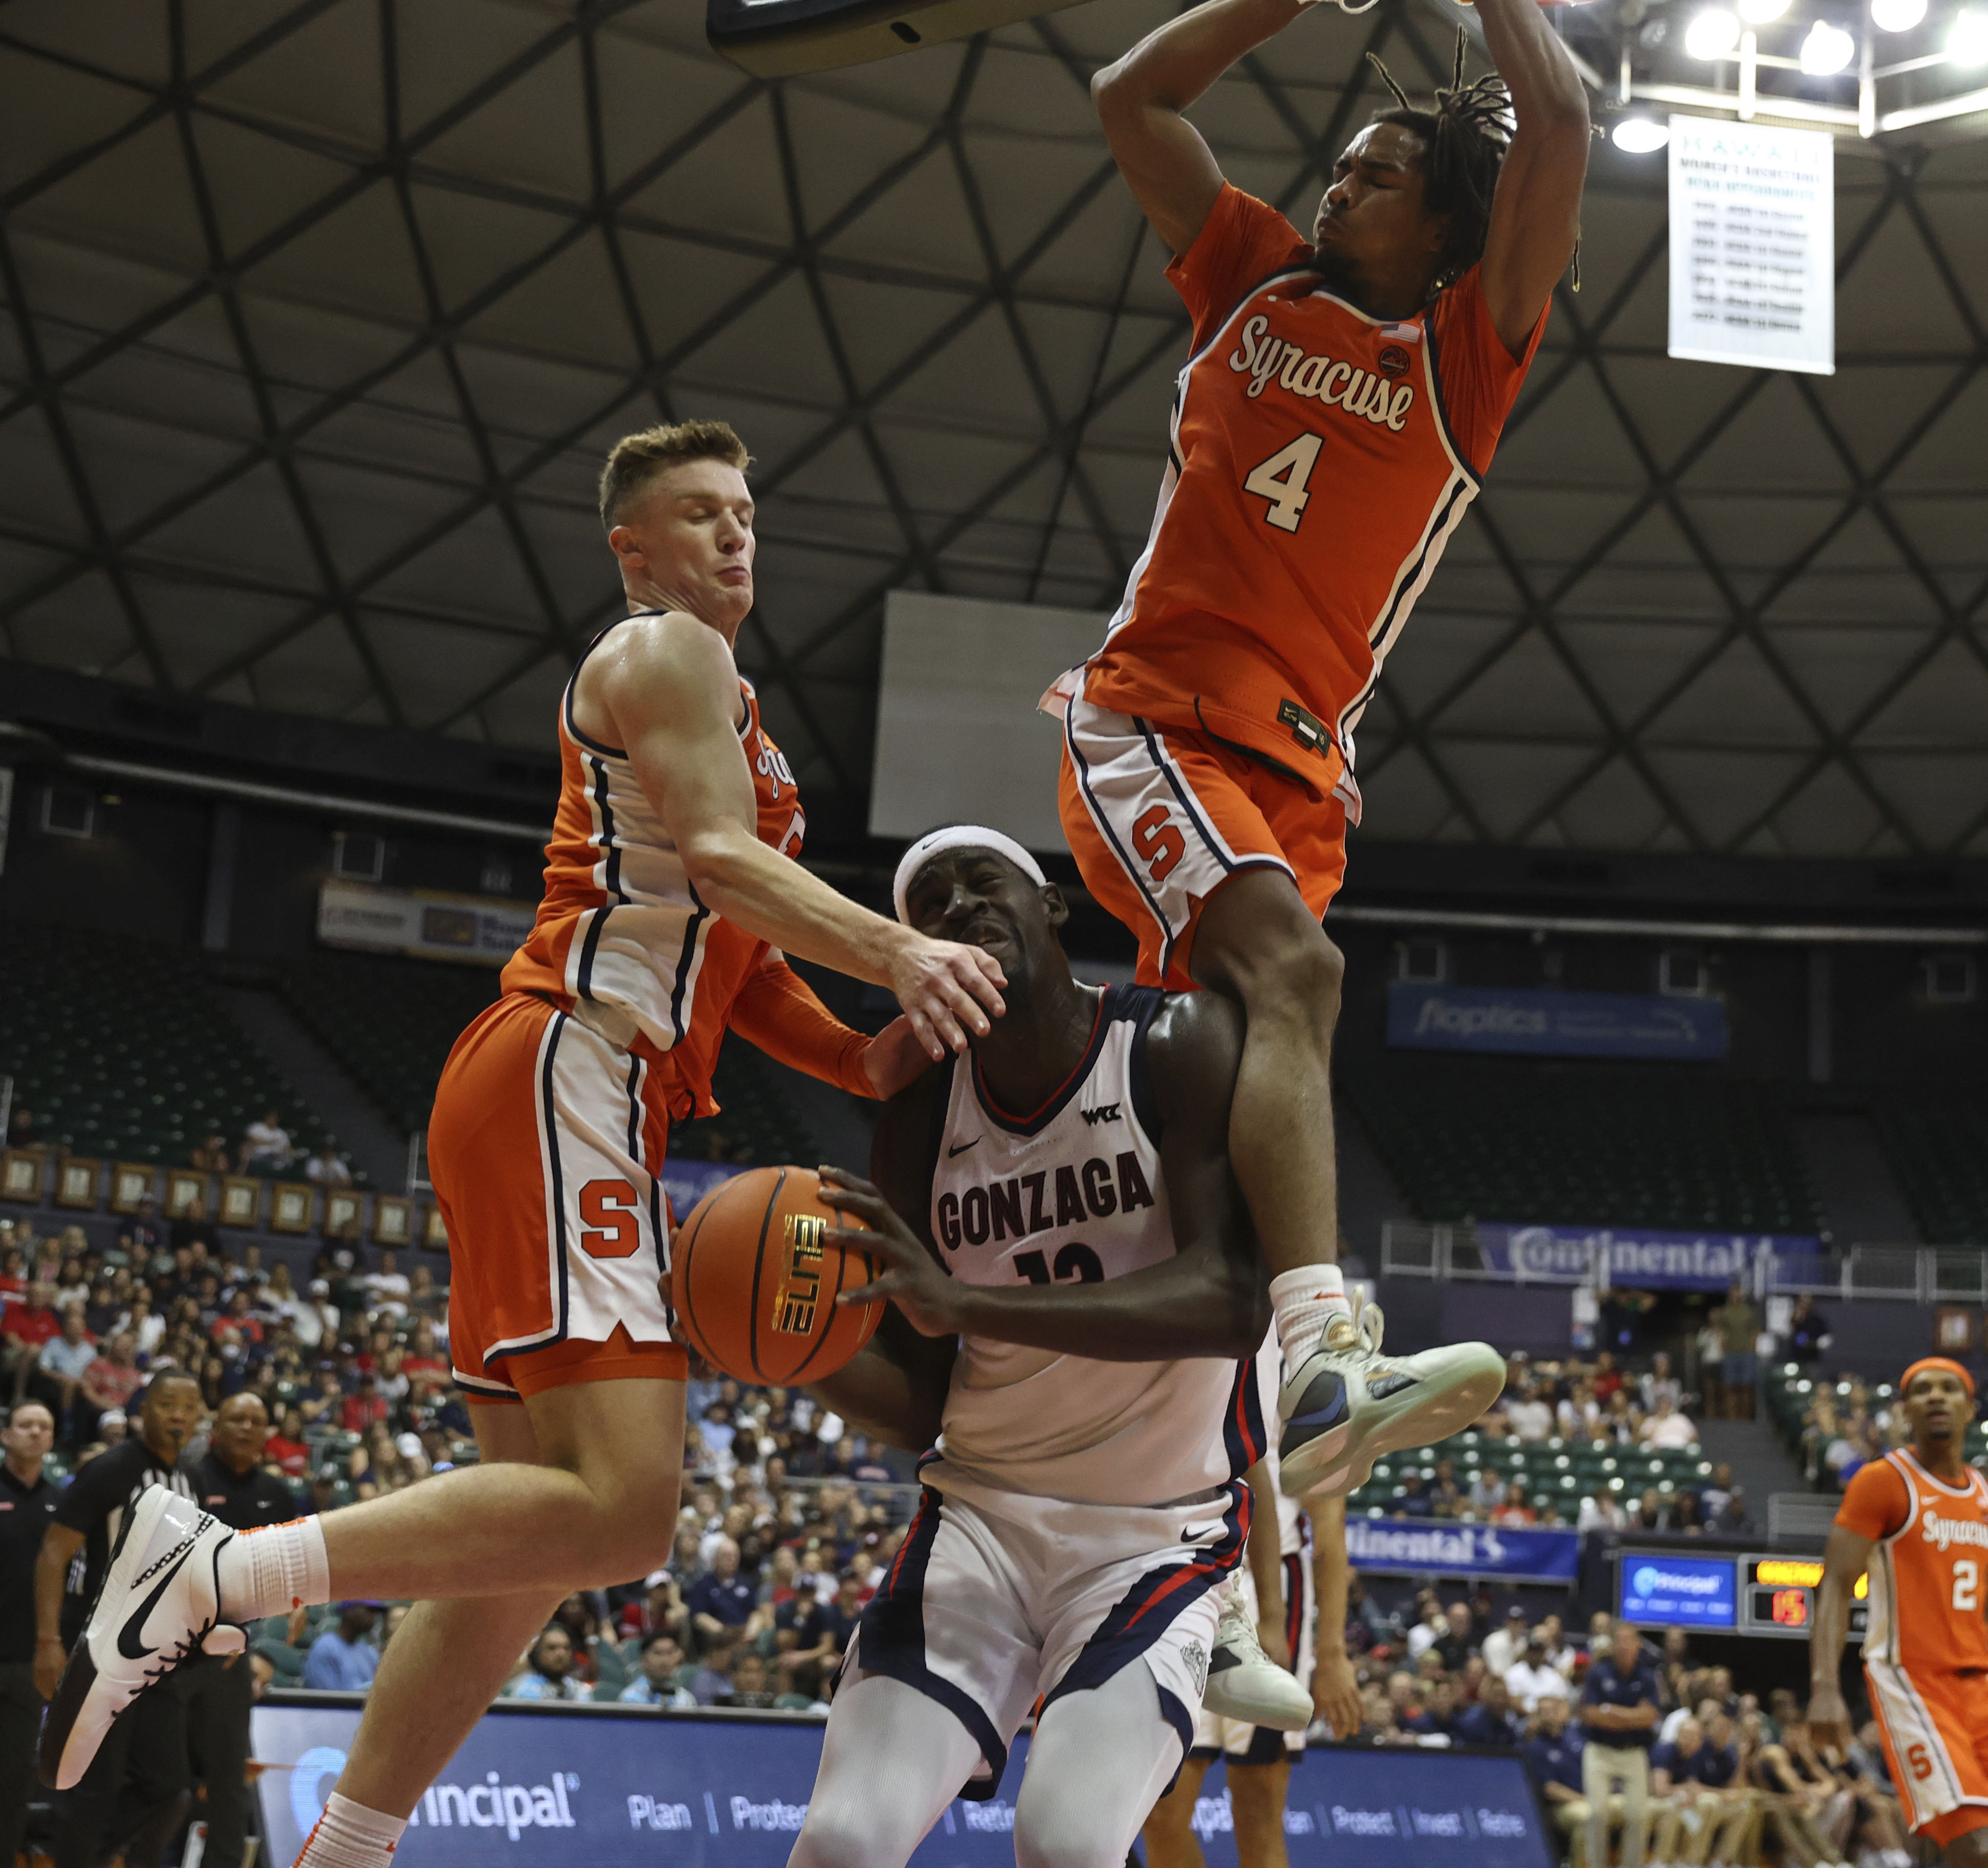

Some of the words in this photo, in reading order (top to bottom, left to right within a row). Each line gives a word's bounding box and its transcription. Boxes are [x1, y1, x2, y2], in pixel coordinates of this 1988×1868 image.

[1229, 314, 1414, 432] Syracuse
[1242, 430, 1326, 535] 4
[1132, 805, 1186, 882] S
[1081, 1102, 1123, 1127] WCC
[579, 1179, 640, 1259] S
[937, 1151, 1155, 1250] GONZAGA
[1952, 1559, 1978, 1611] 2
[1908, 1744, 1932, 1781] S
[409, 1770, 576, 1841] incipal
[626, 1794, 692, 1831] Plan
